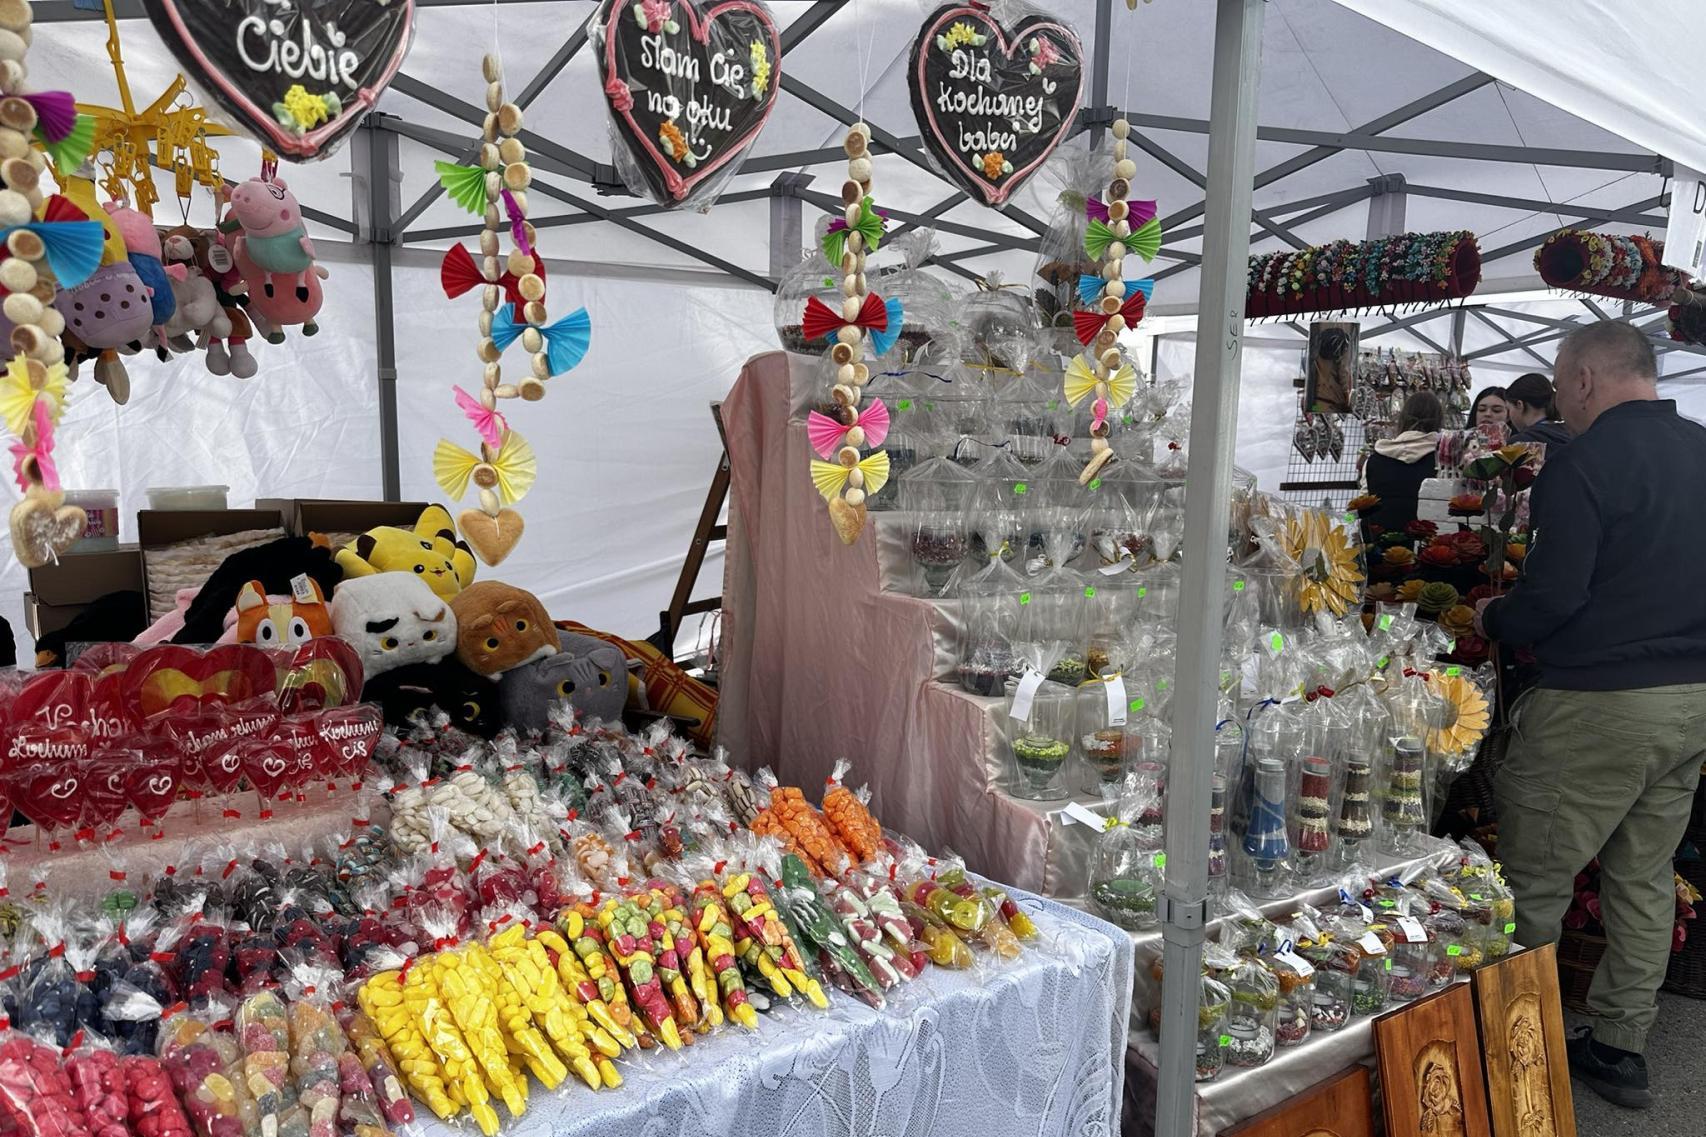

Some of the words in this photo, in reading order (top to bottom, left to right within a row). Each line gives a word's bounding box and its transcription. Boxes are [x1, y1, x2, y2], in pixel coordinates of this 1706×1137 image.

[236, 15, 359, 91] Ciebie
[949, 49, 992, 82] Dla
[648, 90, 681, 120] na
[685, 94, 733, 131] oku
[937, 77, 1057, 134] Kochanej
